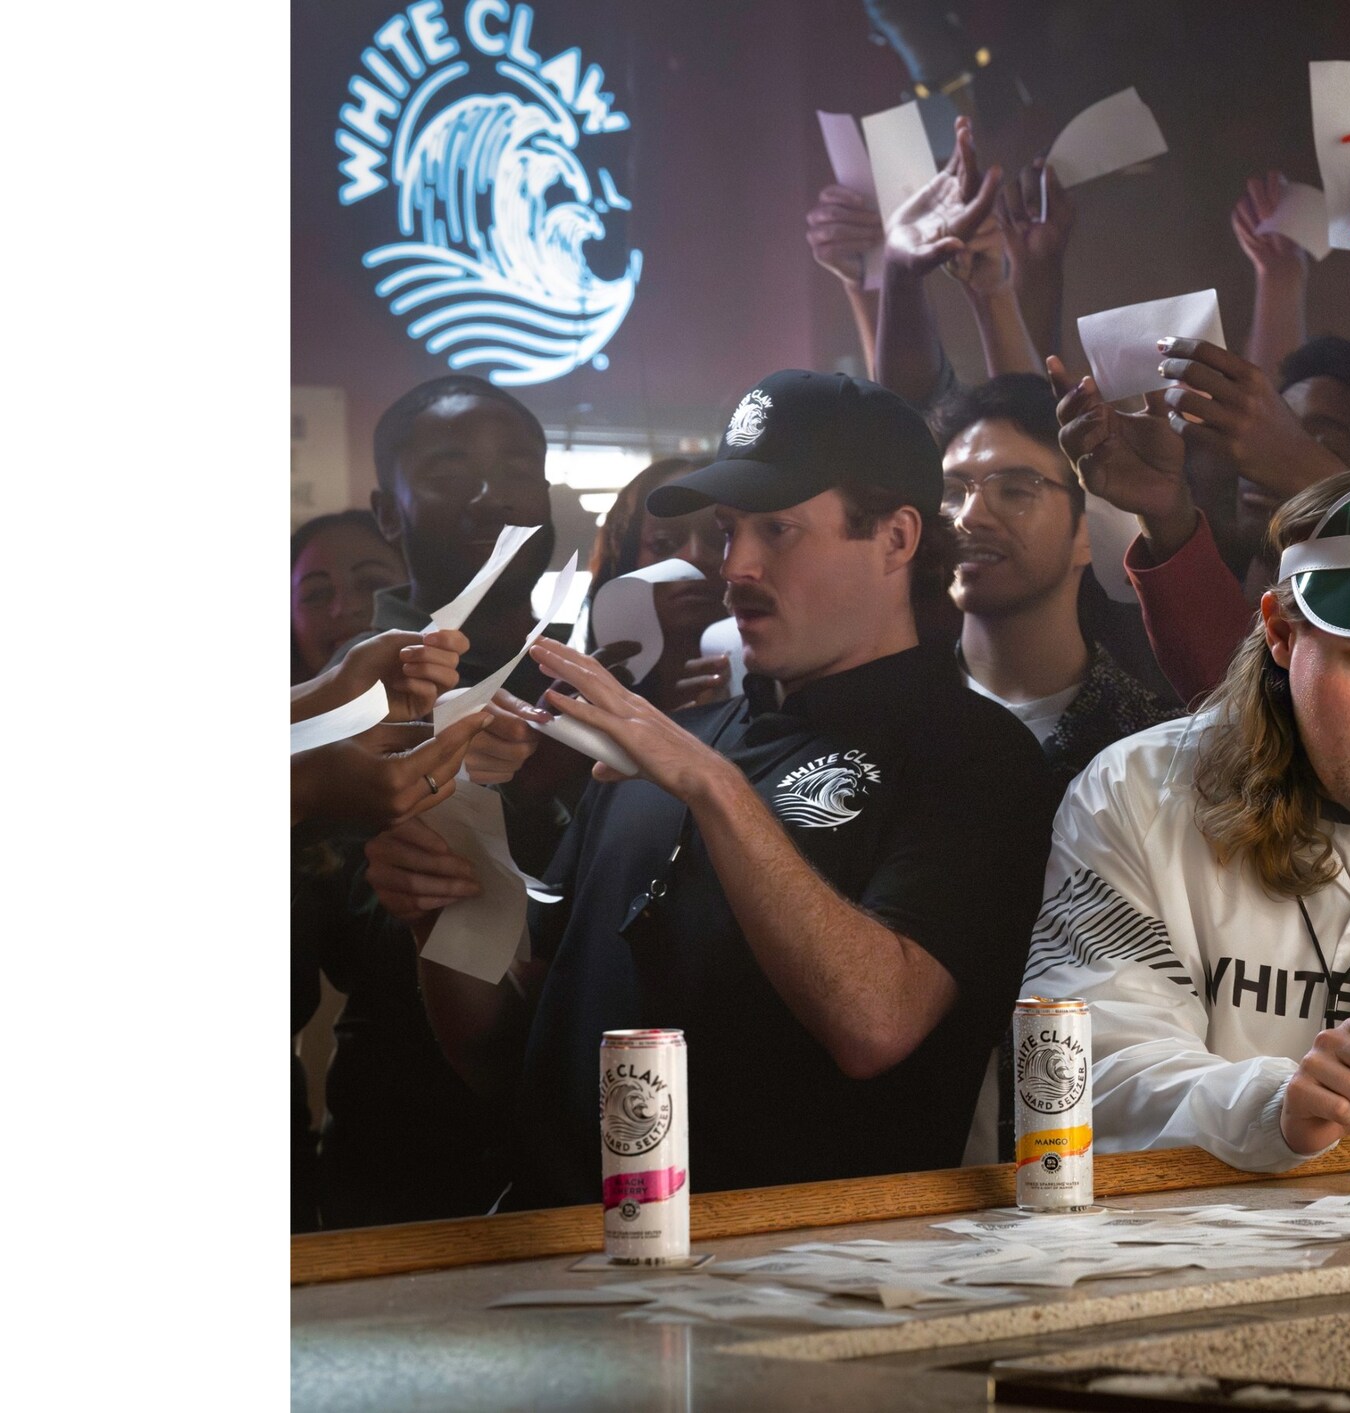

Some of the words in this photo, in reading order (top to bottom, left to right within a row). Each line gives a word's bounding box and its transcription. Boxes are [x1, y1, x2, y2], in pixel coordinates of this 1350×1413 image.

[334, 0, 460, 206] WHITE
[464, 0, 631, 135] CLAW
[752, 389, 774, 408] CLAW
[776, 752, 840, 788] WHITE
[843, 749, 882, 784] CLAW
[1016, 1034, 1038, 1084] WHITE
[1040, 1030, 1084, 1056] CLAW
[617, 1064, 668, 1093] CLAW
[1024, 1092, 1053, 1110] HARD
[1058, 1067, 1085, 1109] SELTZER
[604, 1131, 630, 1151] HARD
[635, 1104, 669, 1150] SELTZER
[1035, 1138, 1068, 1146] MANGO
